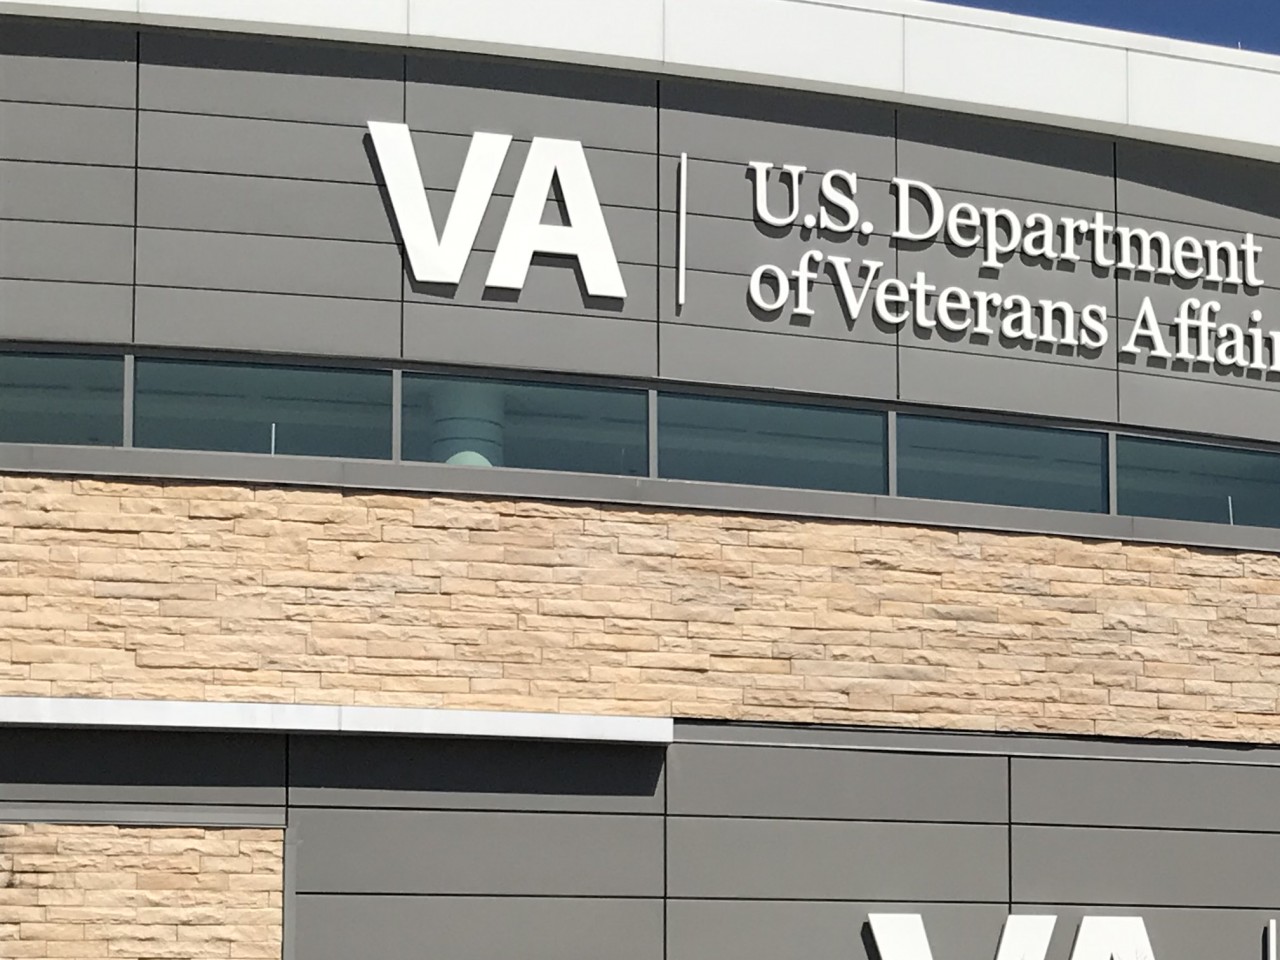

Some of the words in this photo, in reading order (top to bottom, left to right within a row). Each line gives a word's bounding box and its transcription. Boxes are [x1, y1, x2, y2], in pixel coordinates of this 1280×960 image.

[366, 120, 628, 298] VA
[748, 161, 874, 234] U.S.
[891, 177, 1265, 287] Department
[749, 249, 825, 315] of
[826, 255, 1109, 347] Veterans
